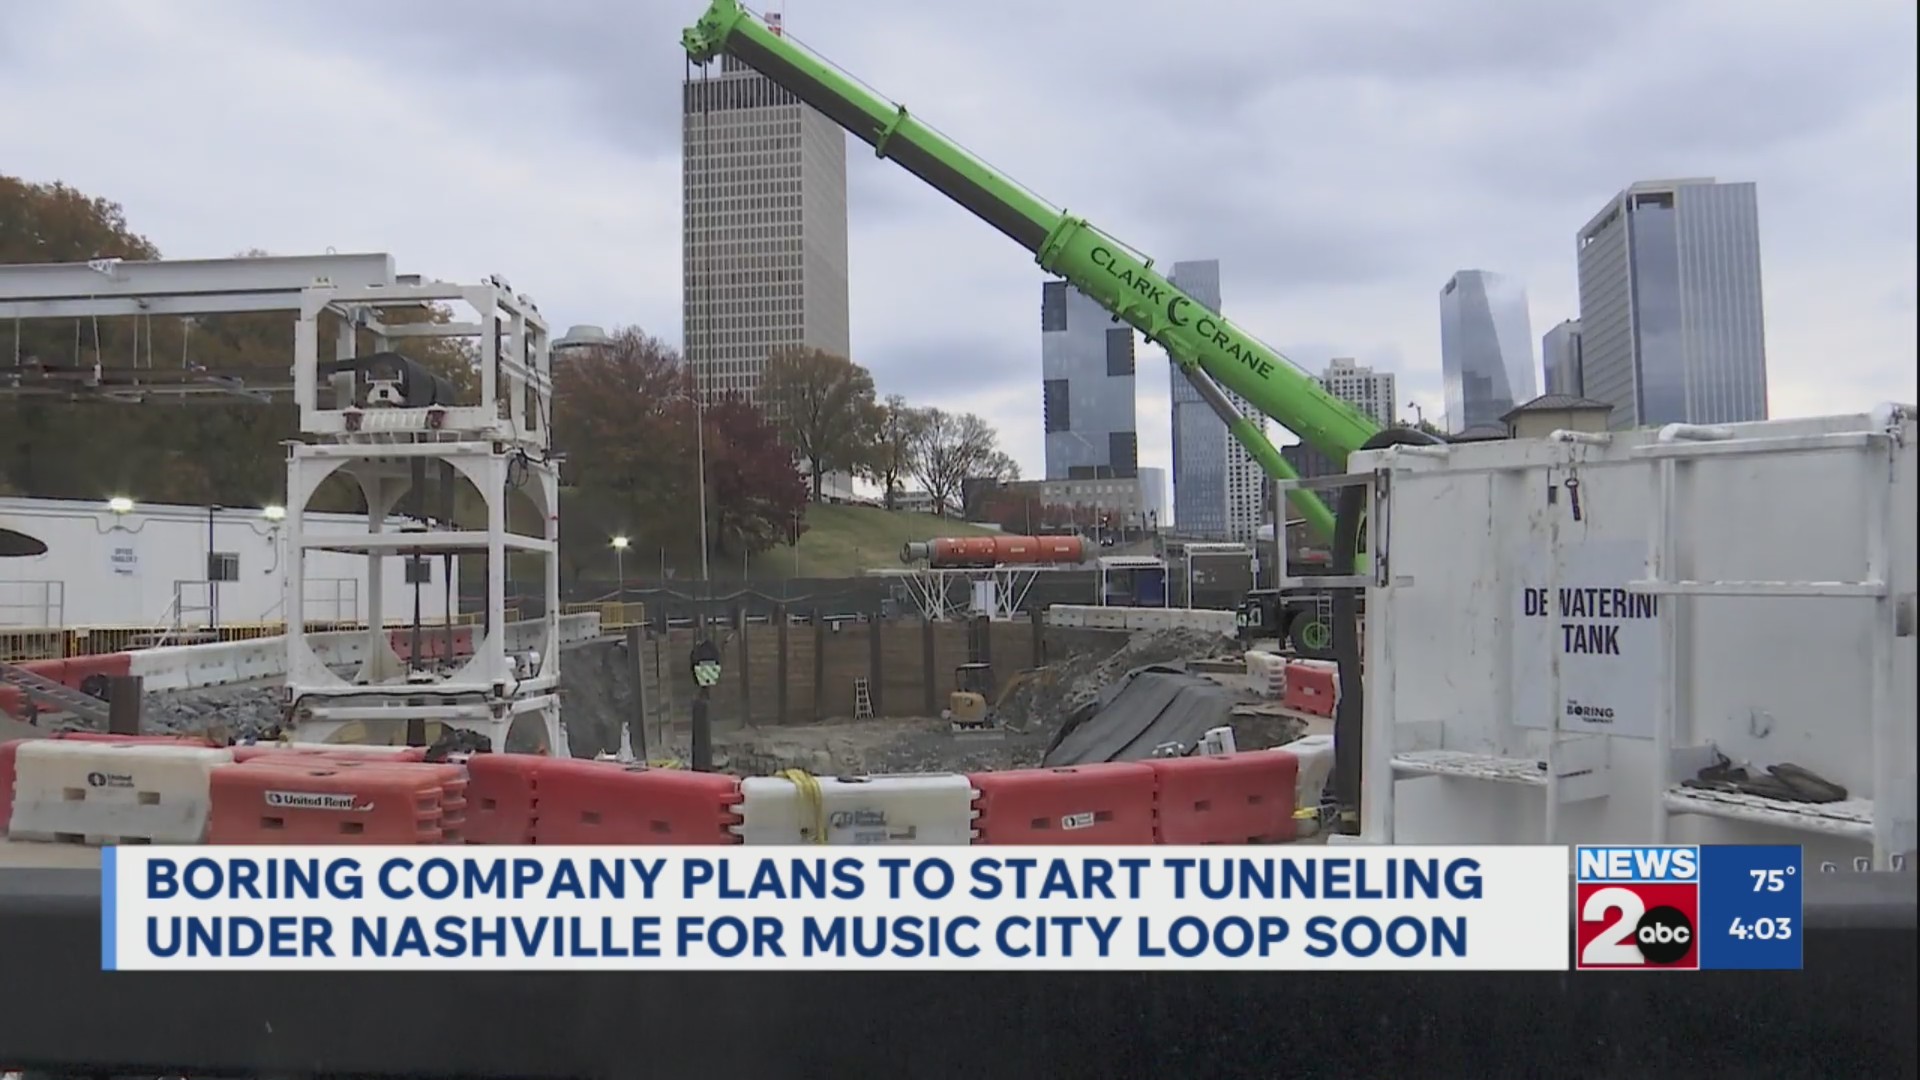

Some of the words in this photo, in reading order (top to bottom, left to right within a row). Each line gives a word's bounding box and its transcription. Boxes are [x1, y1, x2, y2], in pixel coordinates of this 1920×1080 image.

[1090, 246, 1165, 305] CLARK
[1196, 318, 1275, 380] CRANE
[1524, 588, 1658, 619] DEWATERIN
[1561, 624, 1621, 655] TANK
[1566, 705, 1615, 719] BORING
[284, 794, 322, 806] United
